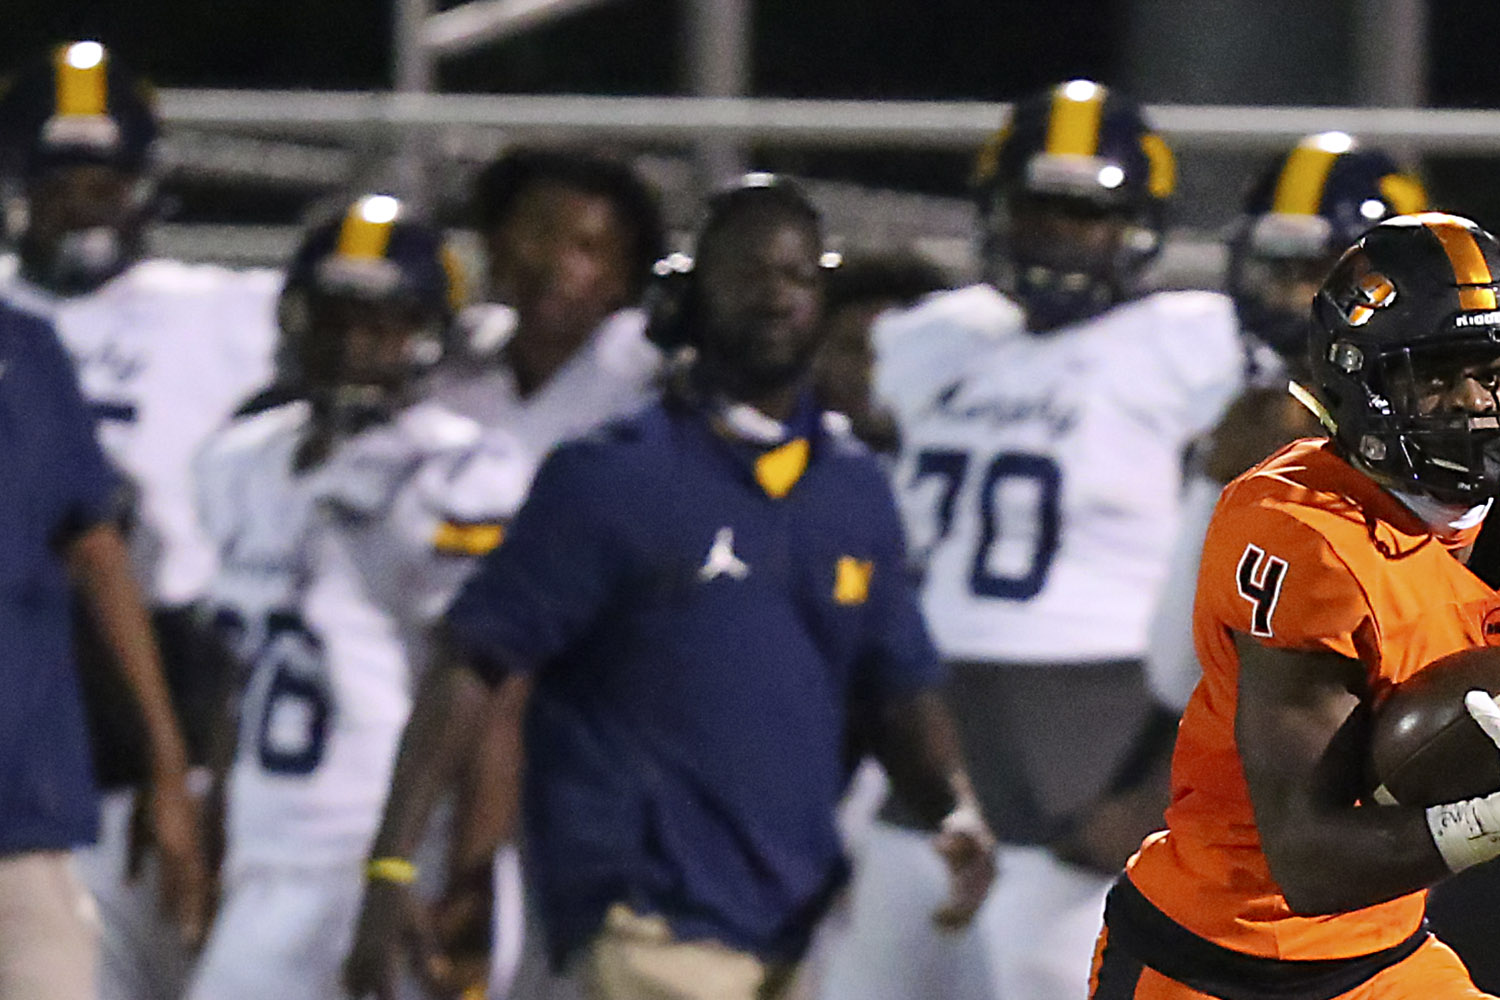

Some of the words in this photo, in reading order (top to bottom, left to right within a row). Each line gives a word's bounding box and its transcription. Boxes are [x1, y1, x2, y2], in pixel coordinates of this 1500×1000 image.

[908, 450, 1064, 602] 70
[1236, 543, 1288, 637] 4
[213, 605, 336, 777] 6
